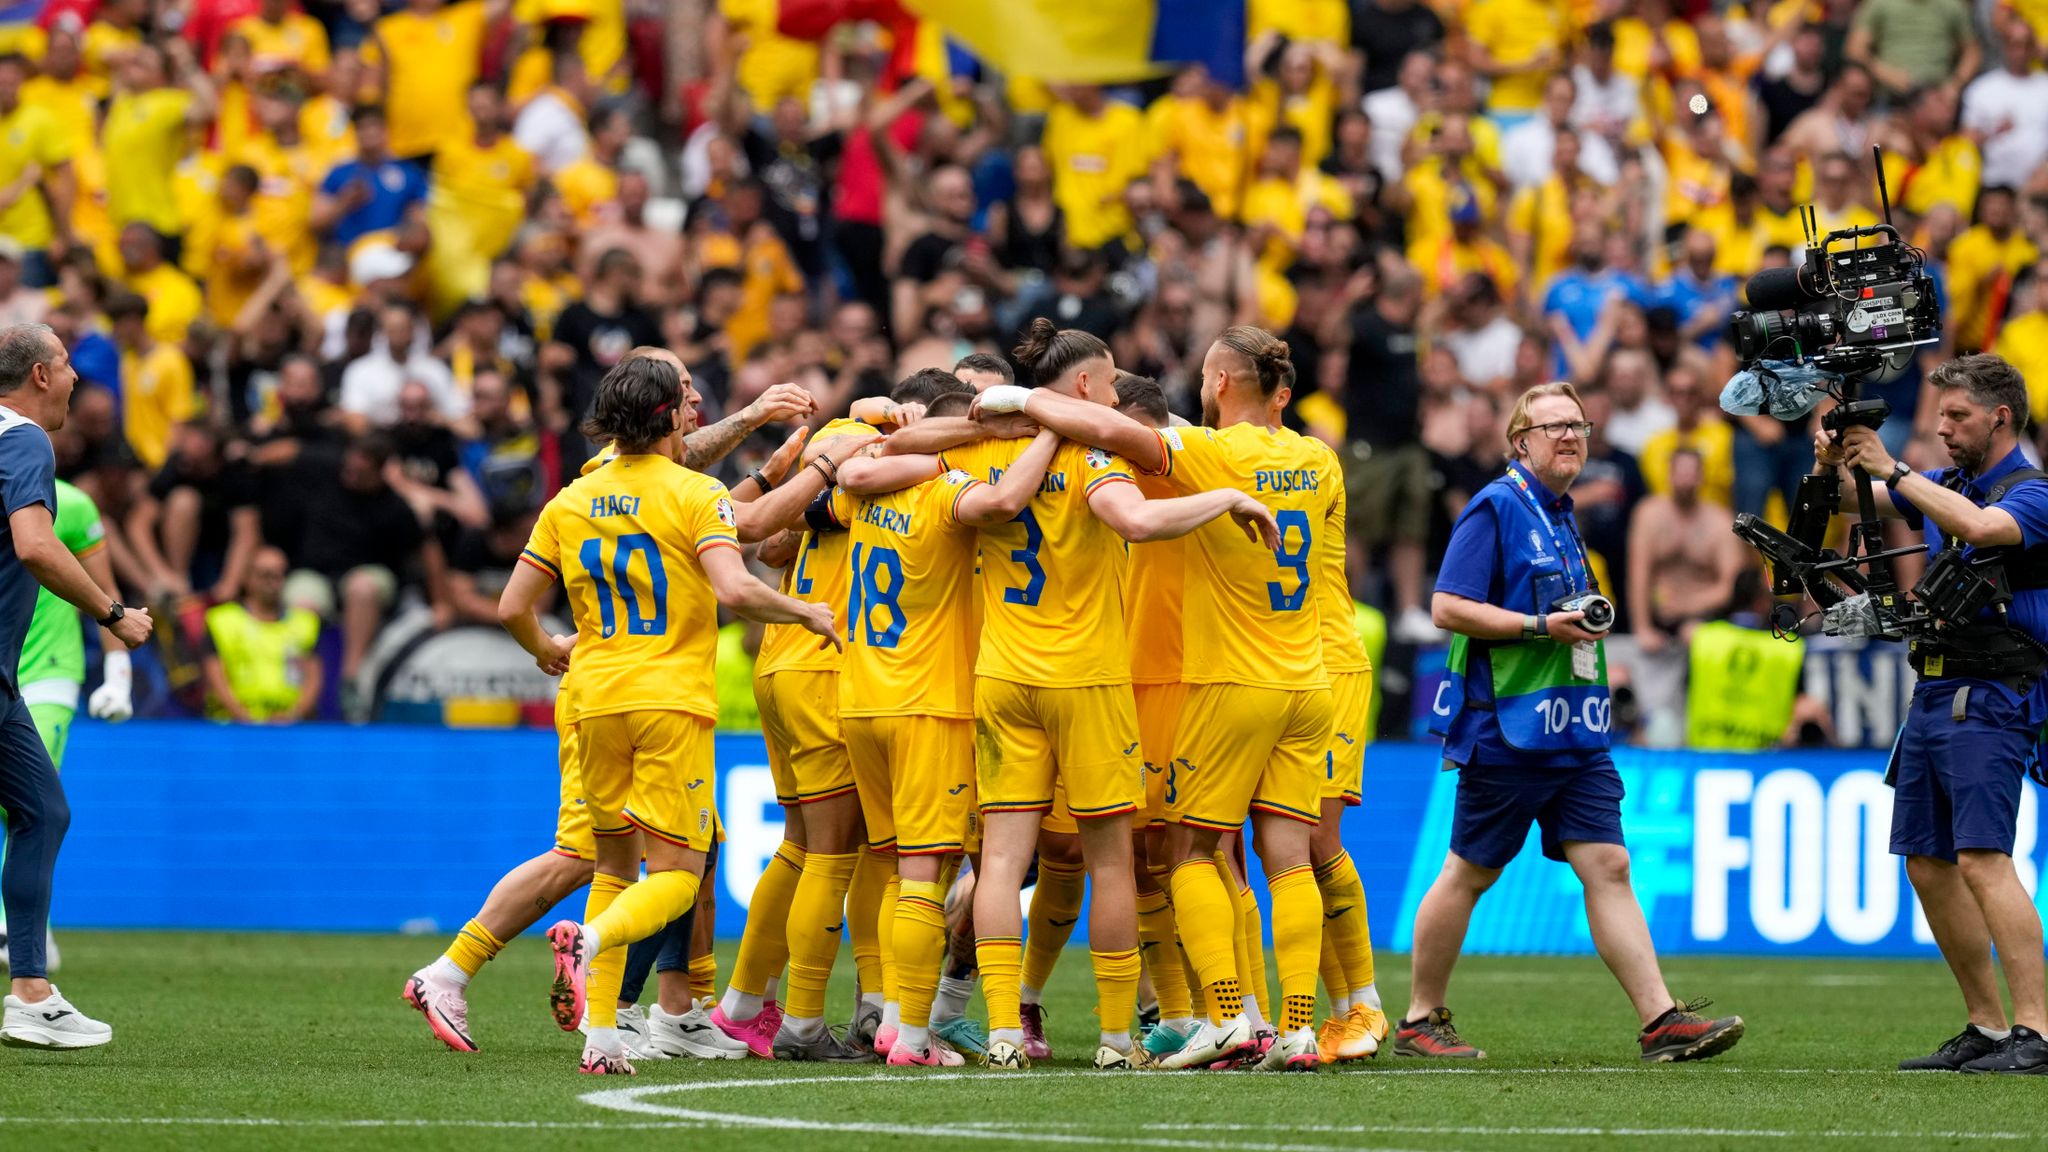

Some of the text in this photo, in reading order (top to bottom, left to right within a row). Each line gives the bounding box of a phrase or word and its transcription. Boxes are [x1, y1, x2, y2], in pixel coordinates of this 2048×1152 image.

[590, 494, 641, 518] HAGI
[1256, 469, 1319, 496] PUȘCAȘ
[579, 532, 669, 640] 10
[848, 541, 908, 649] 18
[1004, 507, 1047, 607] 3
[1267, 510, 1312, 611] 9
